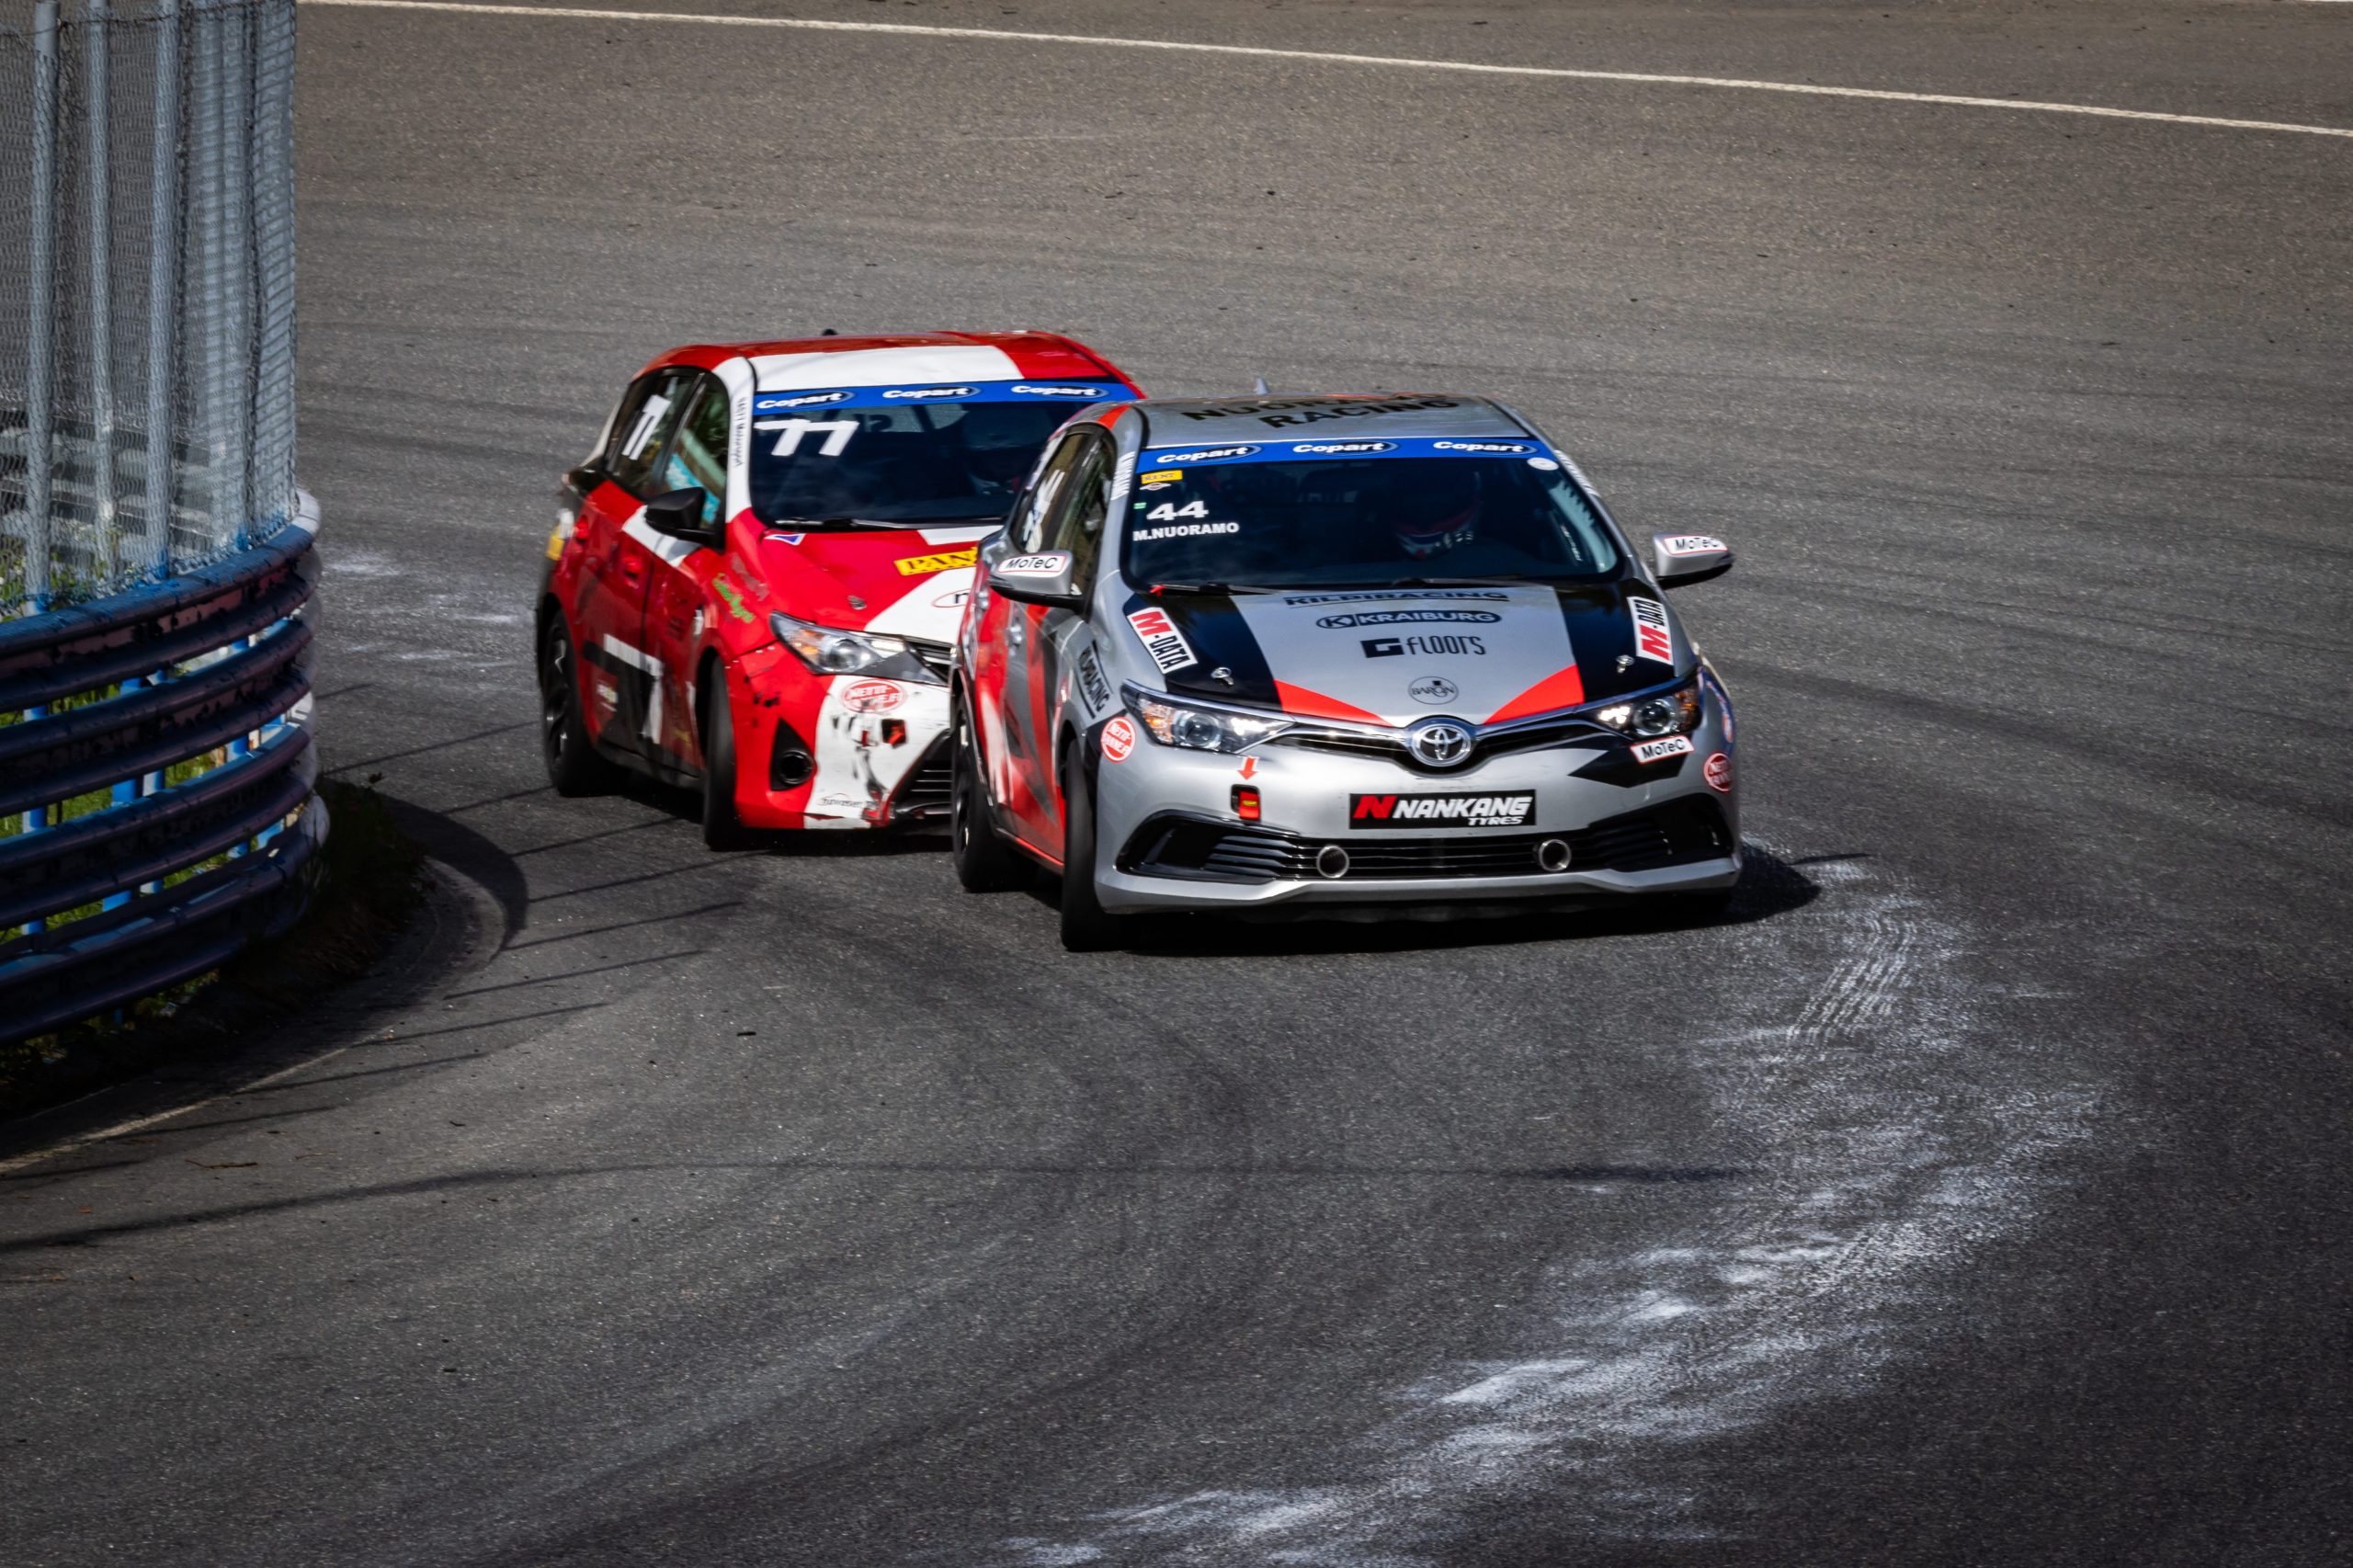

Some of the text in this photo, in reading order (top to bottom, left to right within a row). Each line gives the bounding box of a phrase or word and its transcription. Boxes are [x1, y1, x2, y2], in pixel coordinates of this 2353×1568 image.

[882, 387, 969, 399] Copart
[1011, 385, 1097, 397] Copart
[756, 392, 843, 409] Copart
[1259, 400, 1460, 427] RACING
[1156, 446, 1248, 463] Copart
[1293, 441, 1385, 453] Copart
[1434, 441, 1524, 453] Copart
[1146, 500, 1210, 521] 44
[1132, 522, 1240, 541] M.NUORAMO
[904, 552, 978, 569] PAN
[1006, 557, 1058, 569] MoTeC
[1358, 612, 1495, 625] KRAIBURG
[1641, 738, 1685, 759] MoTeC
[1392, 797, 1533, 819] NANKANG
[1468, 816, 1523, 826] TYRES
